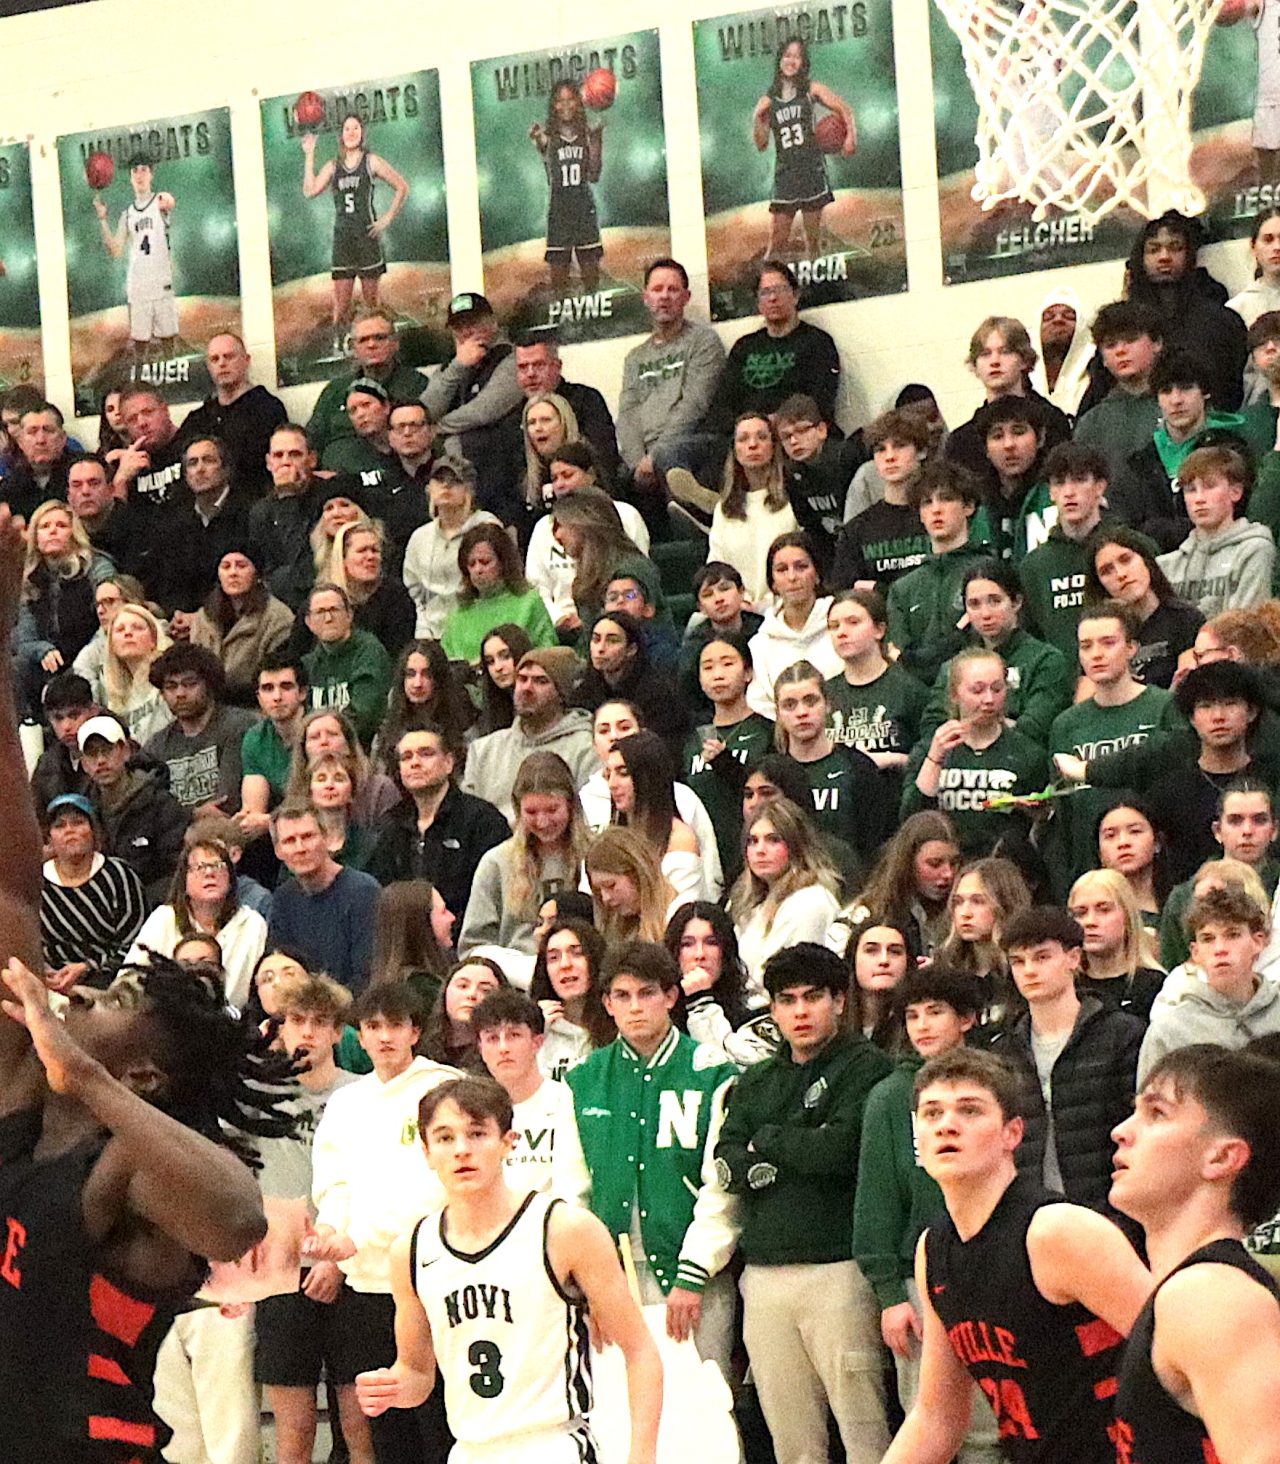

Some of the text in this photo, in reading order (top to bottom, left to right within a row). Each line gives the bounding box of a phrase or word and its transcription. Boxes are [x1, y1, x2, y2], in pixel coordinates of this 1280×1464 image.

[775, 105, 802, 124] NOVI
[780, 123, 805, 149] 23
[558, 146, 583, 160] NOVI
[561, 164, 581, 187] 10
[140, 235, 151, 255] 4
[548, 292, 613, 324] PAYNE
[656, 1090, 704, 1150] N
[444, 1283, 515, 1328] NOVI
[467, 1339, 505, 1399] 3
